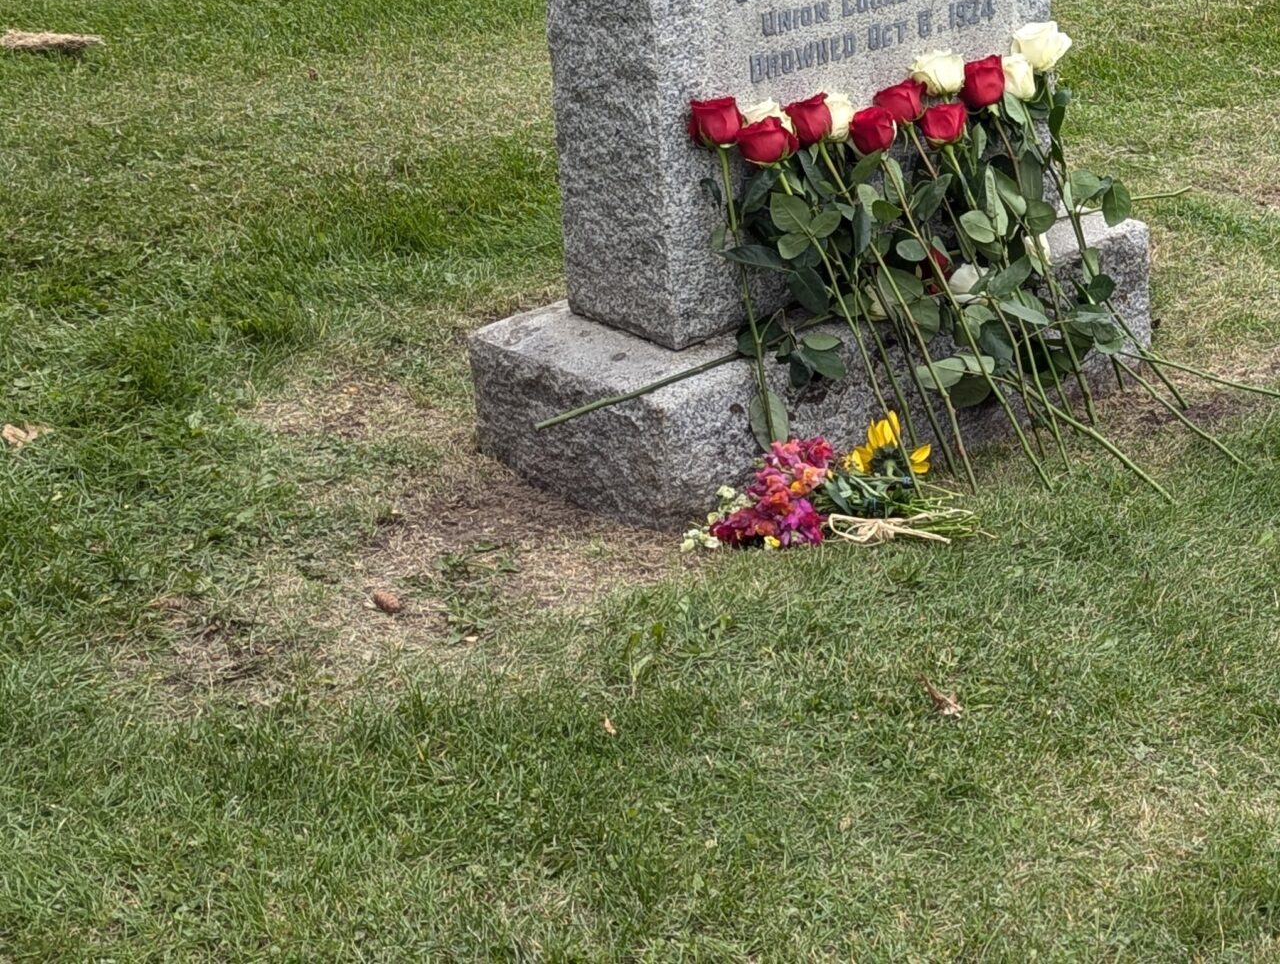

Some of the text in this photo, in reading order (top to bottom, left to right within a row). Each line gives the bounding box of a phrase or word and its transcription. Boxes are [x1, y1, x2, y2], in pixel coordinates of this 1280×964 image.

[762, 2, 829, 36] UNION
[750, 33, 857, 84] DROWNED
[868, 19, 908, 51] OCT
